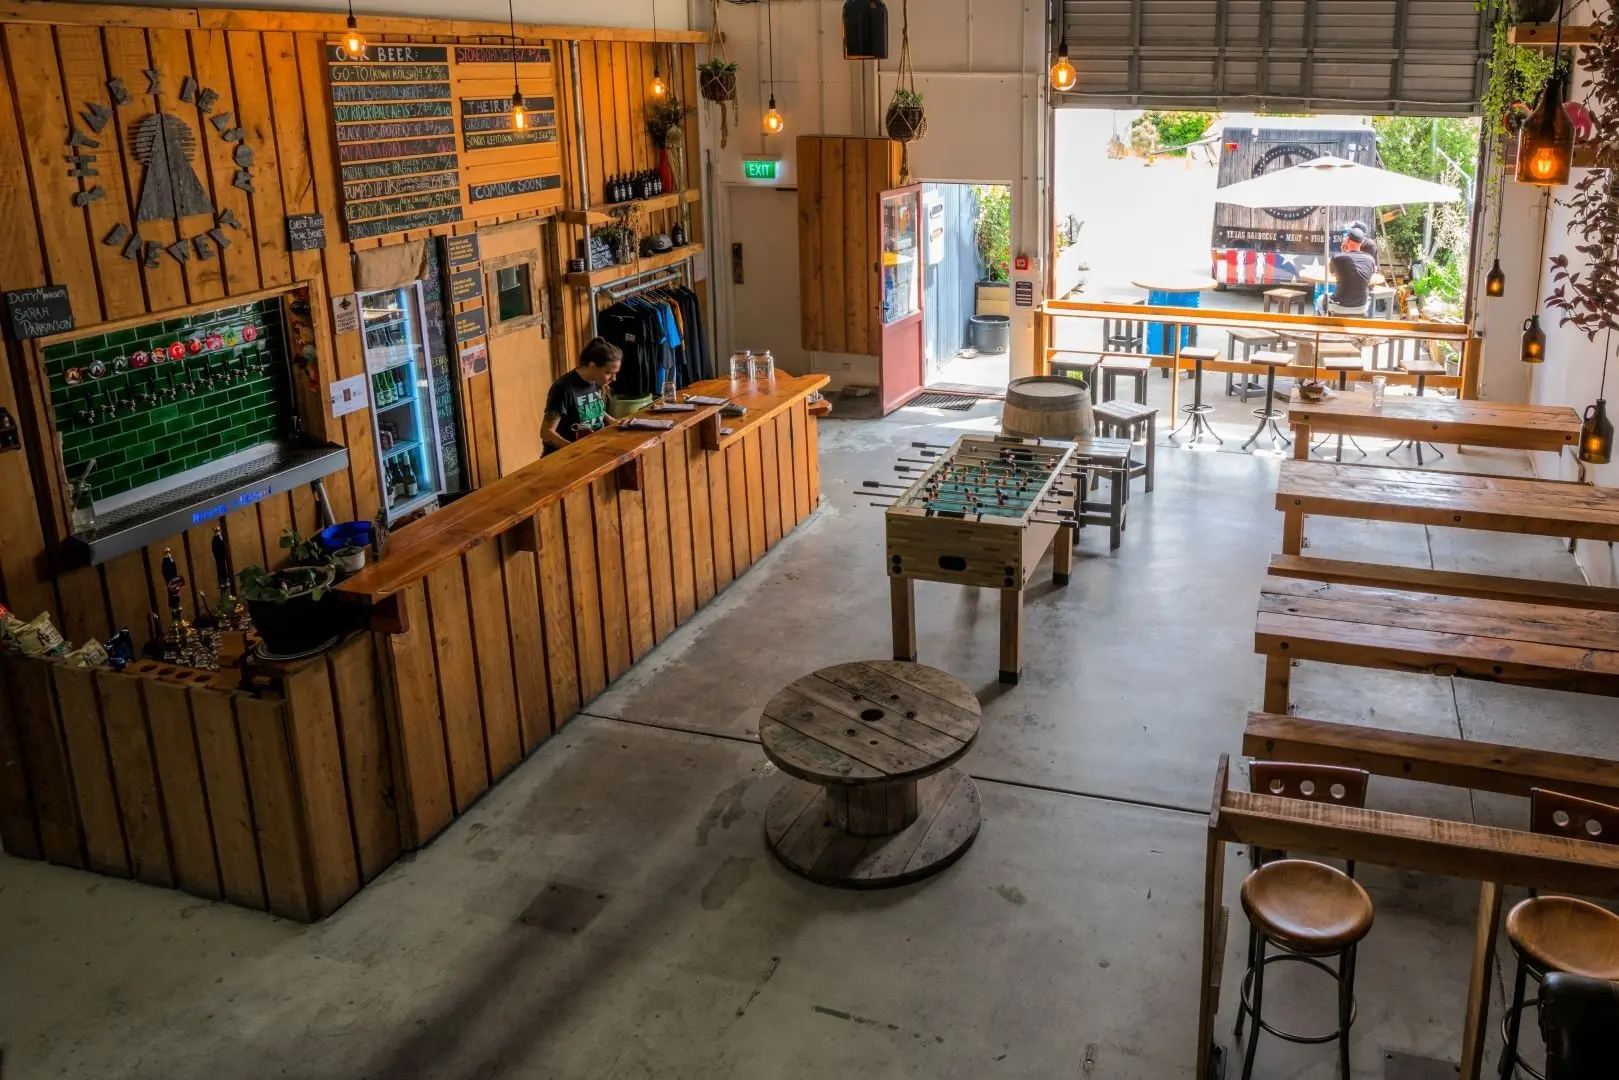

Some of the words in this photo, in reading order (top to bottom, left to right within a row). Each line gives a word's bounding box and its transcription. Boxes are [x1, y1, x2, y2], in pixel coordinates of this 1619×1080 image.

[335, 46, 370, 61] OR
[467, 100, 501, 114] THEIR
[749, 164, 770, 176] EXIT
[475, 182, 513, 199] COMING
[8, 292, 36, 304] DUTY
[15, 307, 49, 320] SARAH
[20, 316, 72, 335] PARKINSON
